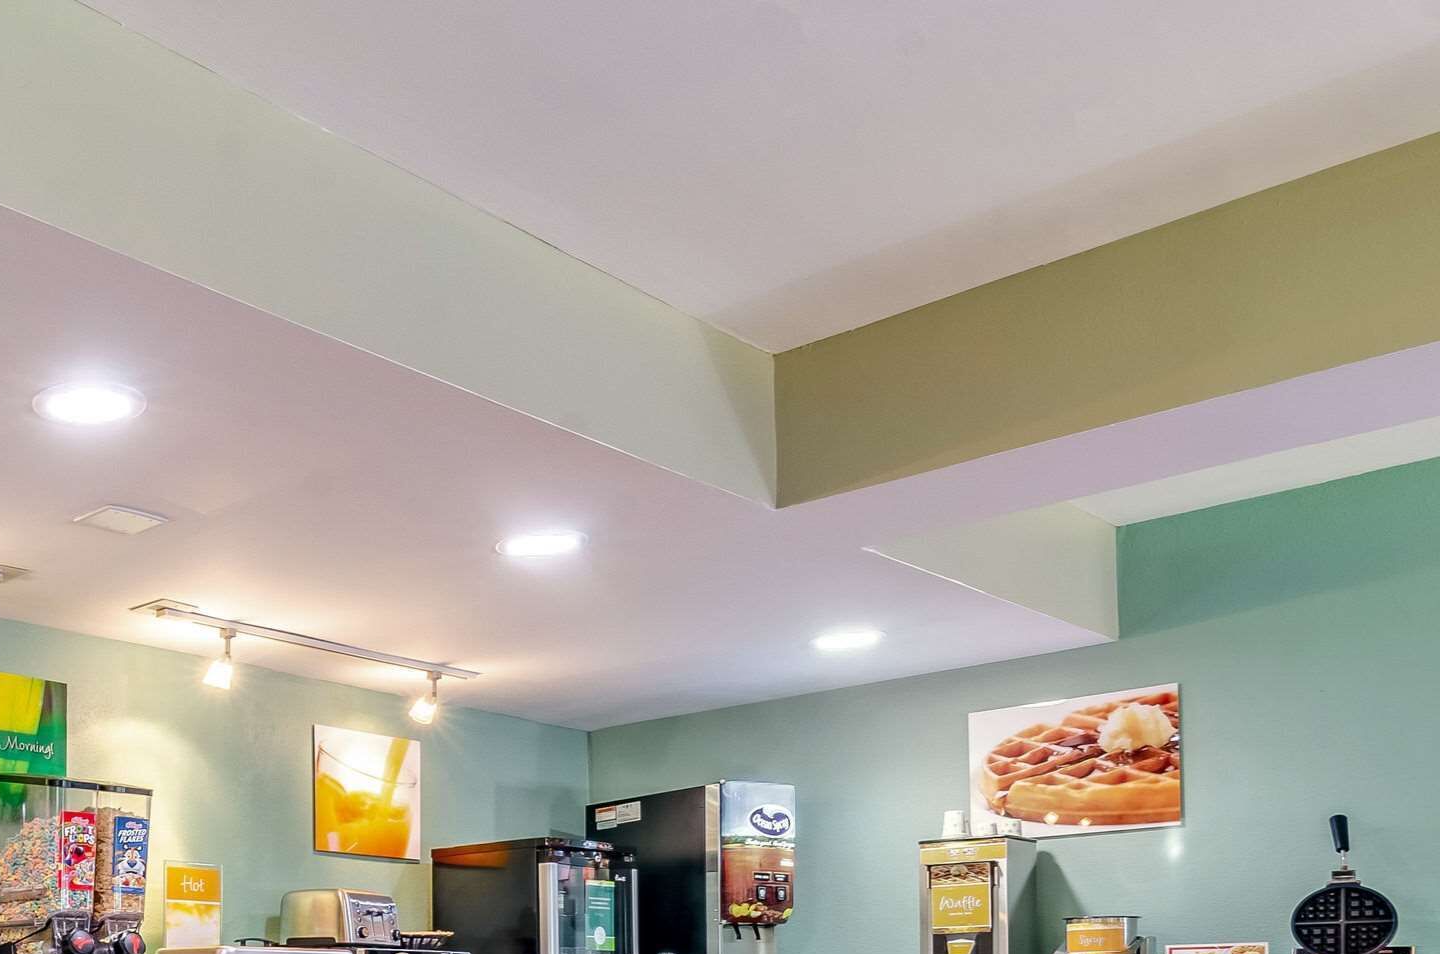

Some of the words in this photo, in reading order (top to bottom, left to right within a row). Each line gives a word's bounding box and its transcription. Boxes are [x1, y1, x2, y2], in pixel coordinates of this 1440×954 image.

[0, 736, 55, 759] Morning!
[752, 813, 772, 830] Ocean
[69, 833, 95, 845] LOOPS
[118, 829, 147, 837] FROSTED
[120, 835, 145, 844] FLAKES
[180, 874, 206, 893] Hot
[939, 896, 983, 912] Waffle
